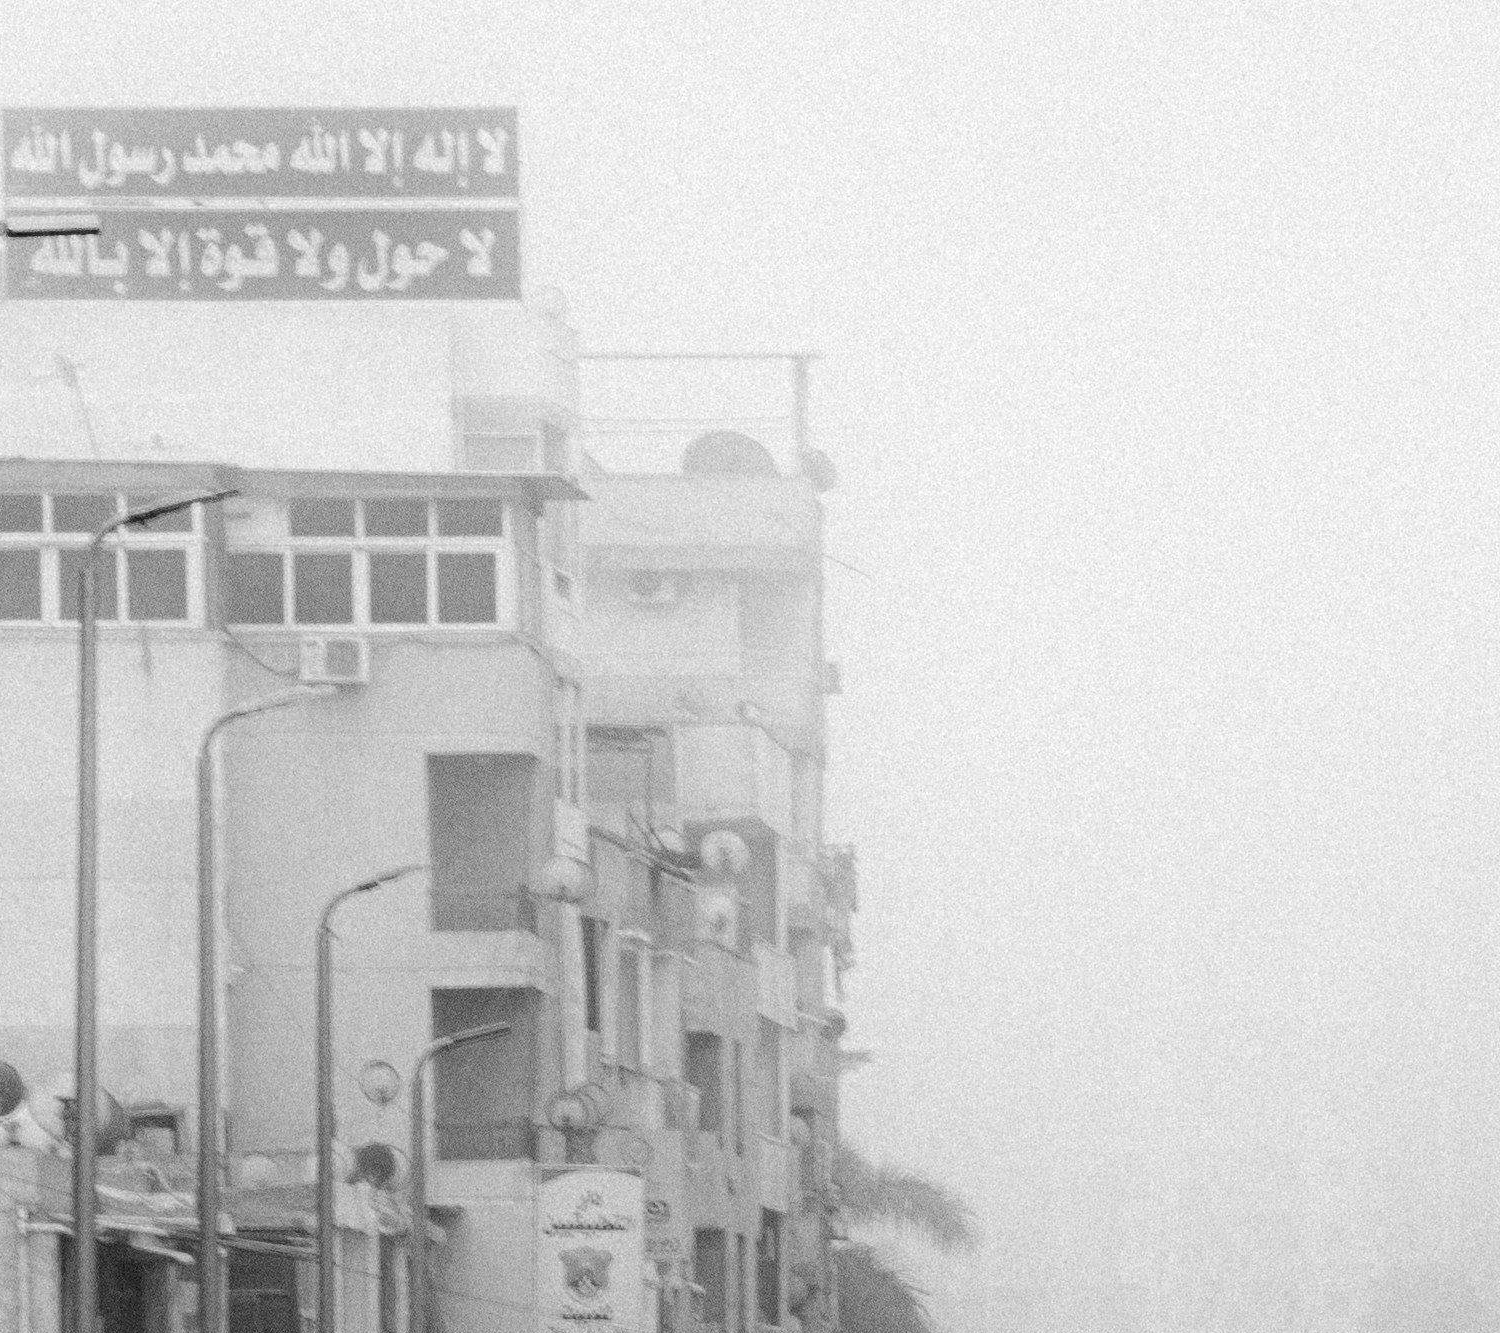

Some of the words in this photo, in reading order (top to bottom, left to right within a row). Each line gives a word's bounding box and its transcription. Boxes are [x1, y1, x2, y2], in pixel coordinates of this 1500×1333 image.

[11, 125, 73, 174] الله
[77, 130, 176, 189] رسول
[182, 130, 279, 175] محمد
[289, 119, 350, 175] الله
[359, 126, 404, 188] إلا
[413, 129, 470, 187] إله
[477, 127, 508, 175] لا
[29, 232, 129, 293] بالله
[139, 227, 191, 291] إلا
[199, 224, 279, 291] قوة
[289, 227, 348, 290] ولا
[356, 227, 448, 291] حول
[459, 226, 497, 277] لا
